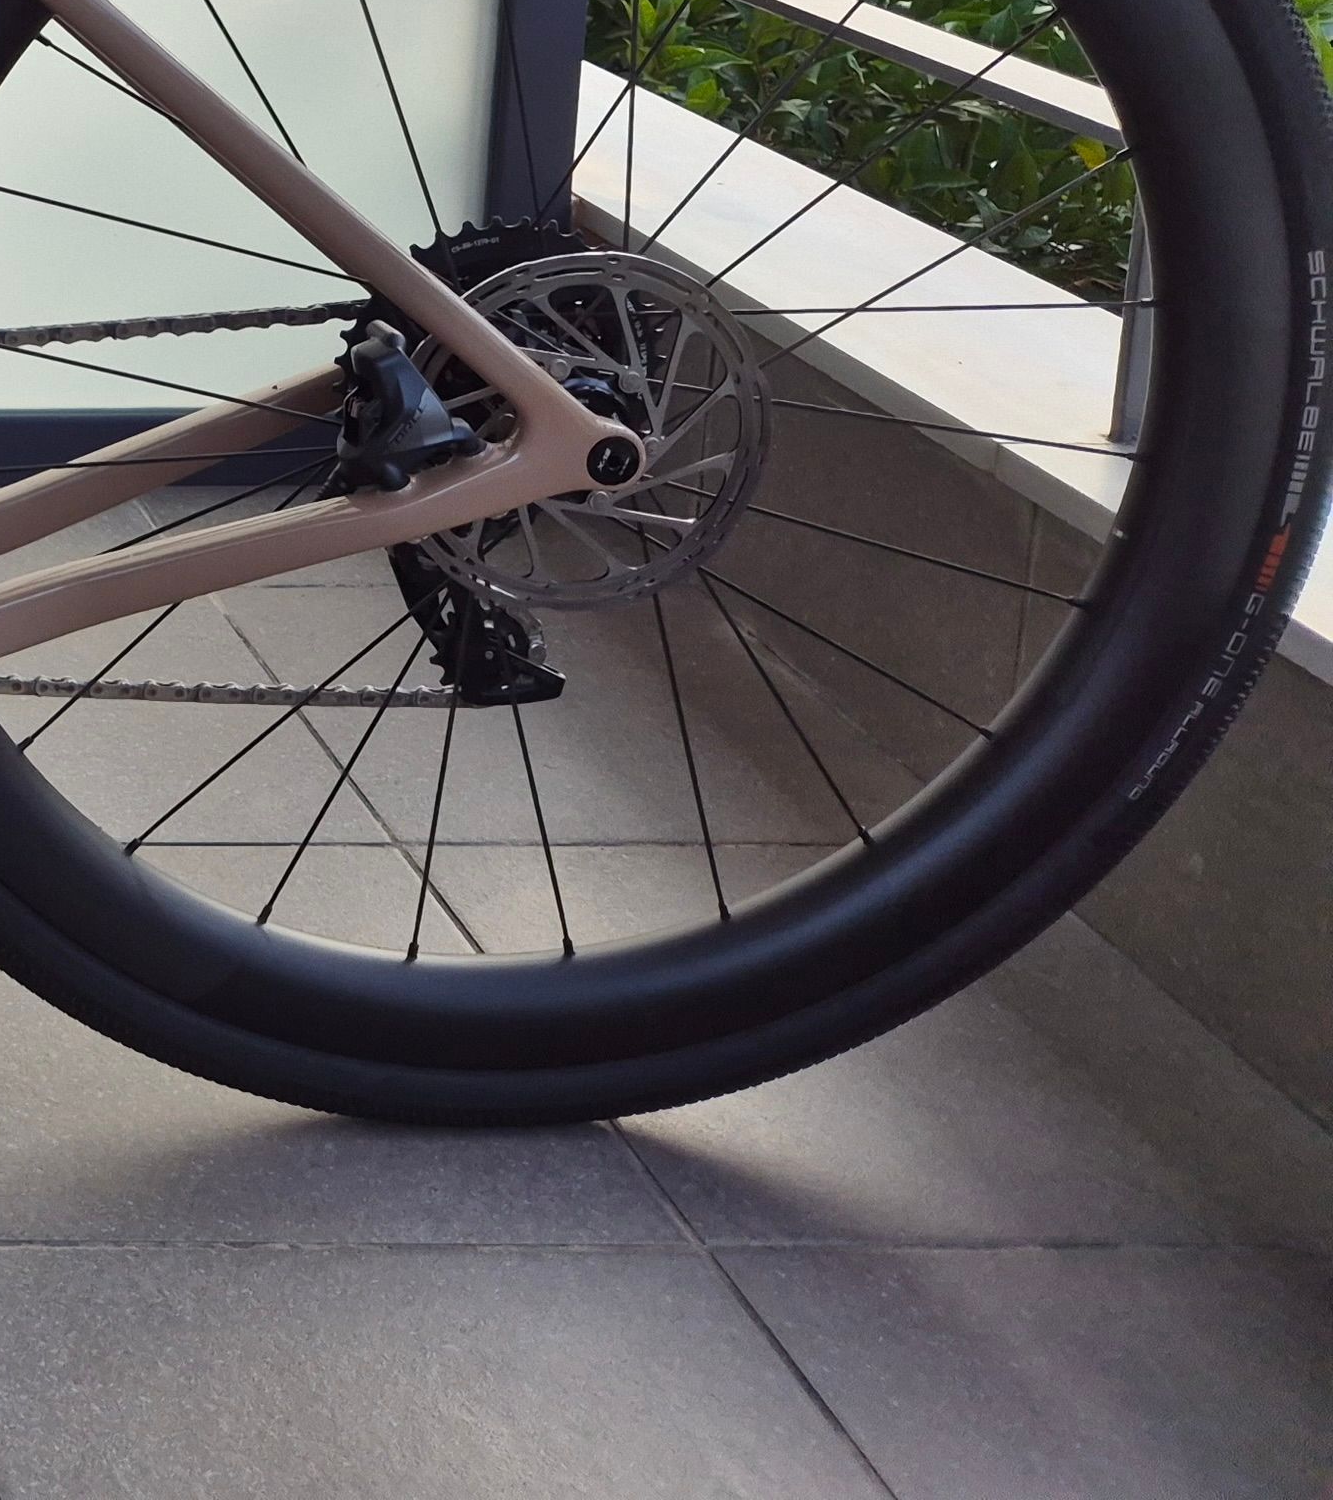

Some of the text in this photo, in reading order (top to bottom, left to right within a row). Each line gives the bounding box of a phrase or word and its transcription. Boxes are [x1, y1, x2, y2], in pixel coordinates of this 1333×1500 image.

[1128, 250, 1327, 800] SCHWALBE G-ONE ALLROUND
